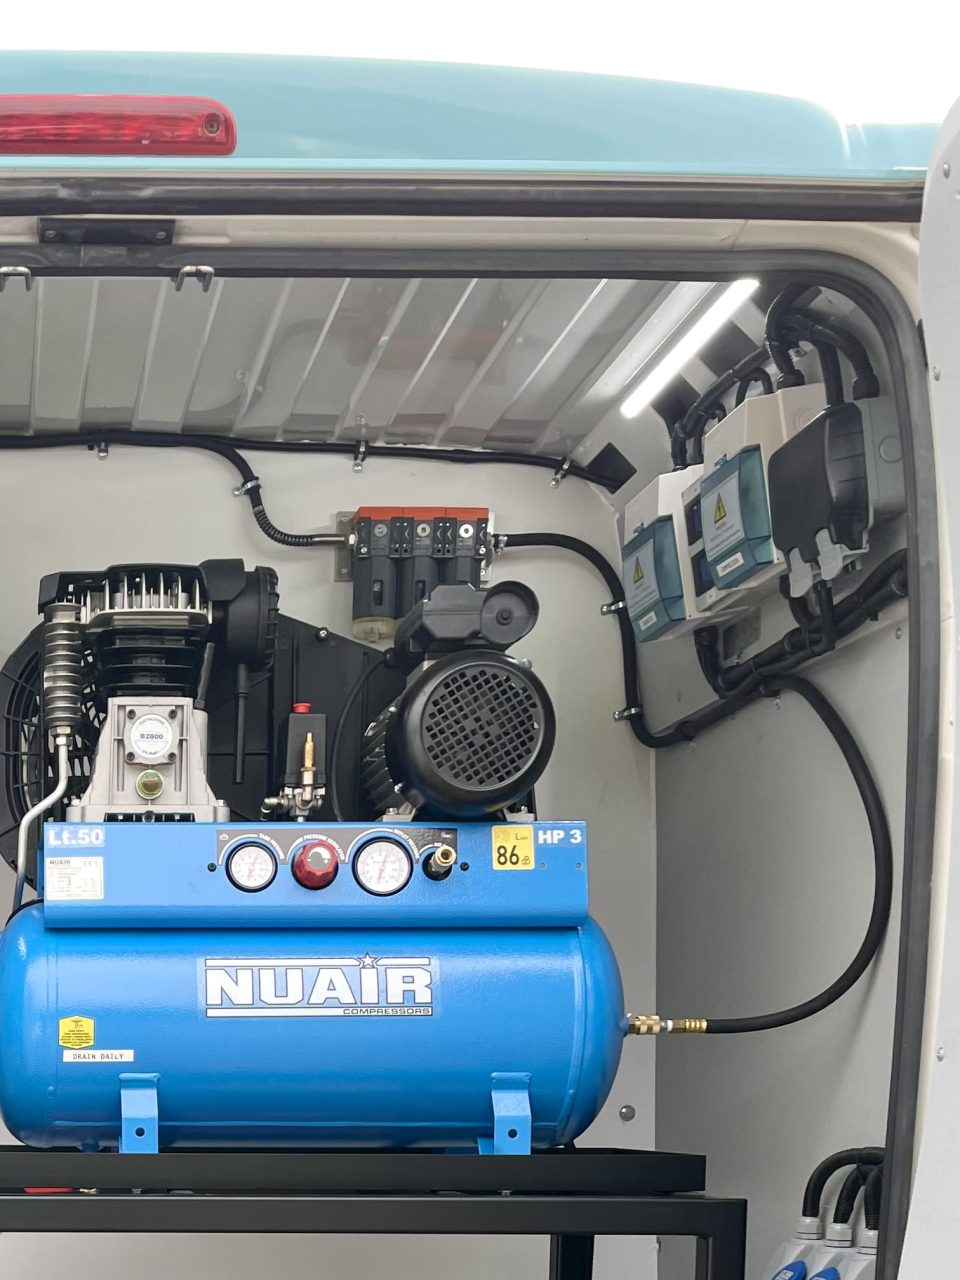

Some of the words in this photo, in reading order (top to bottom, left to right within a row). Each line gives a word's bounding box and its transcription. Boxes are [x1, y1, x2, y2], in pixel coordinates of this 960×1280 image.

[48, 829, 104, 846] Lt.50
[538, 829, 565, 844] HP
[569, 829, 582, 844] 3
[497, 845, 519, 865] 86
[205, 967, 433, 1006] NUAIR
